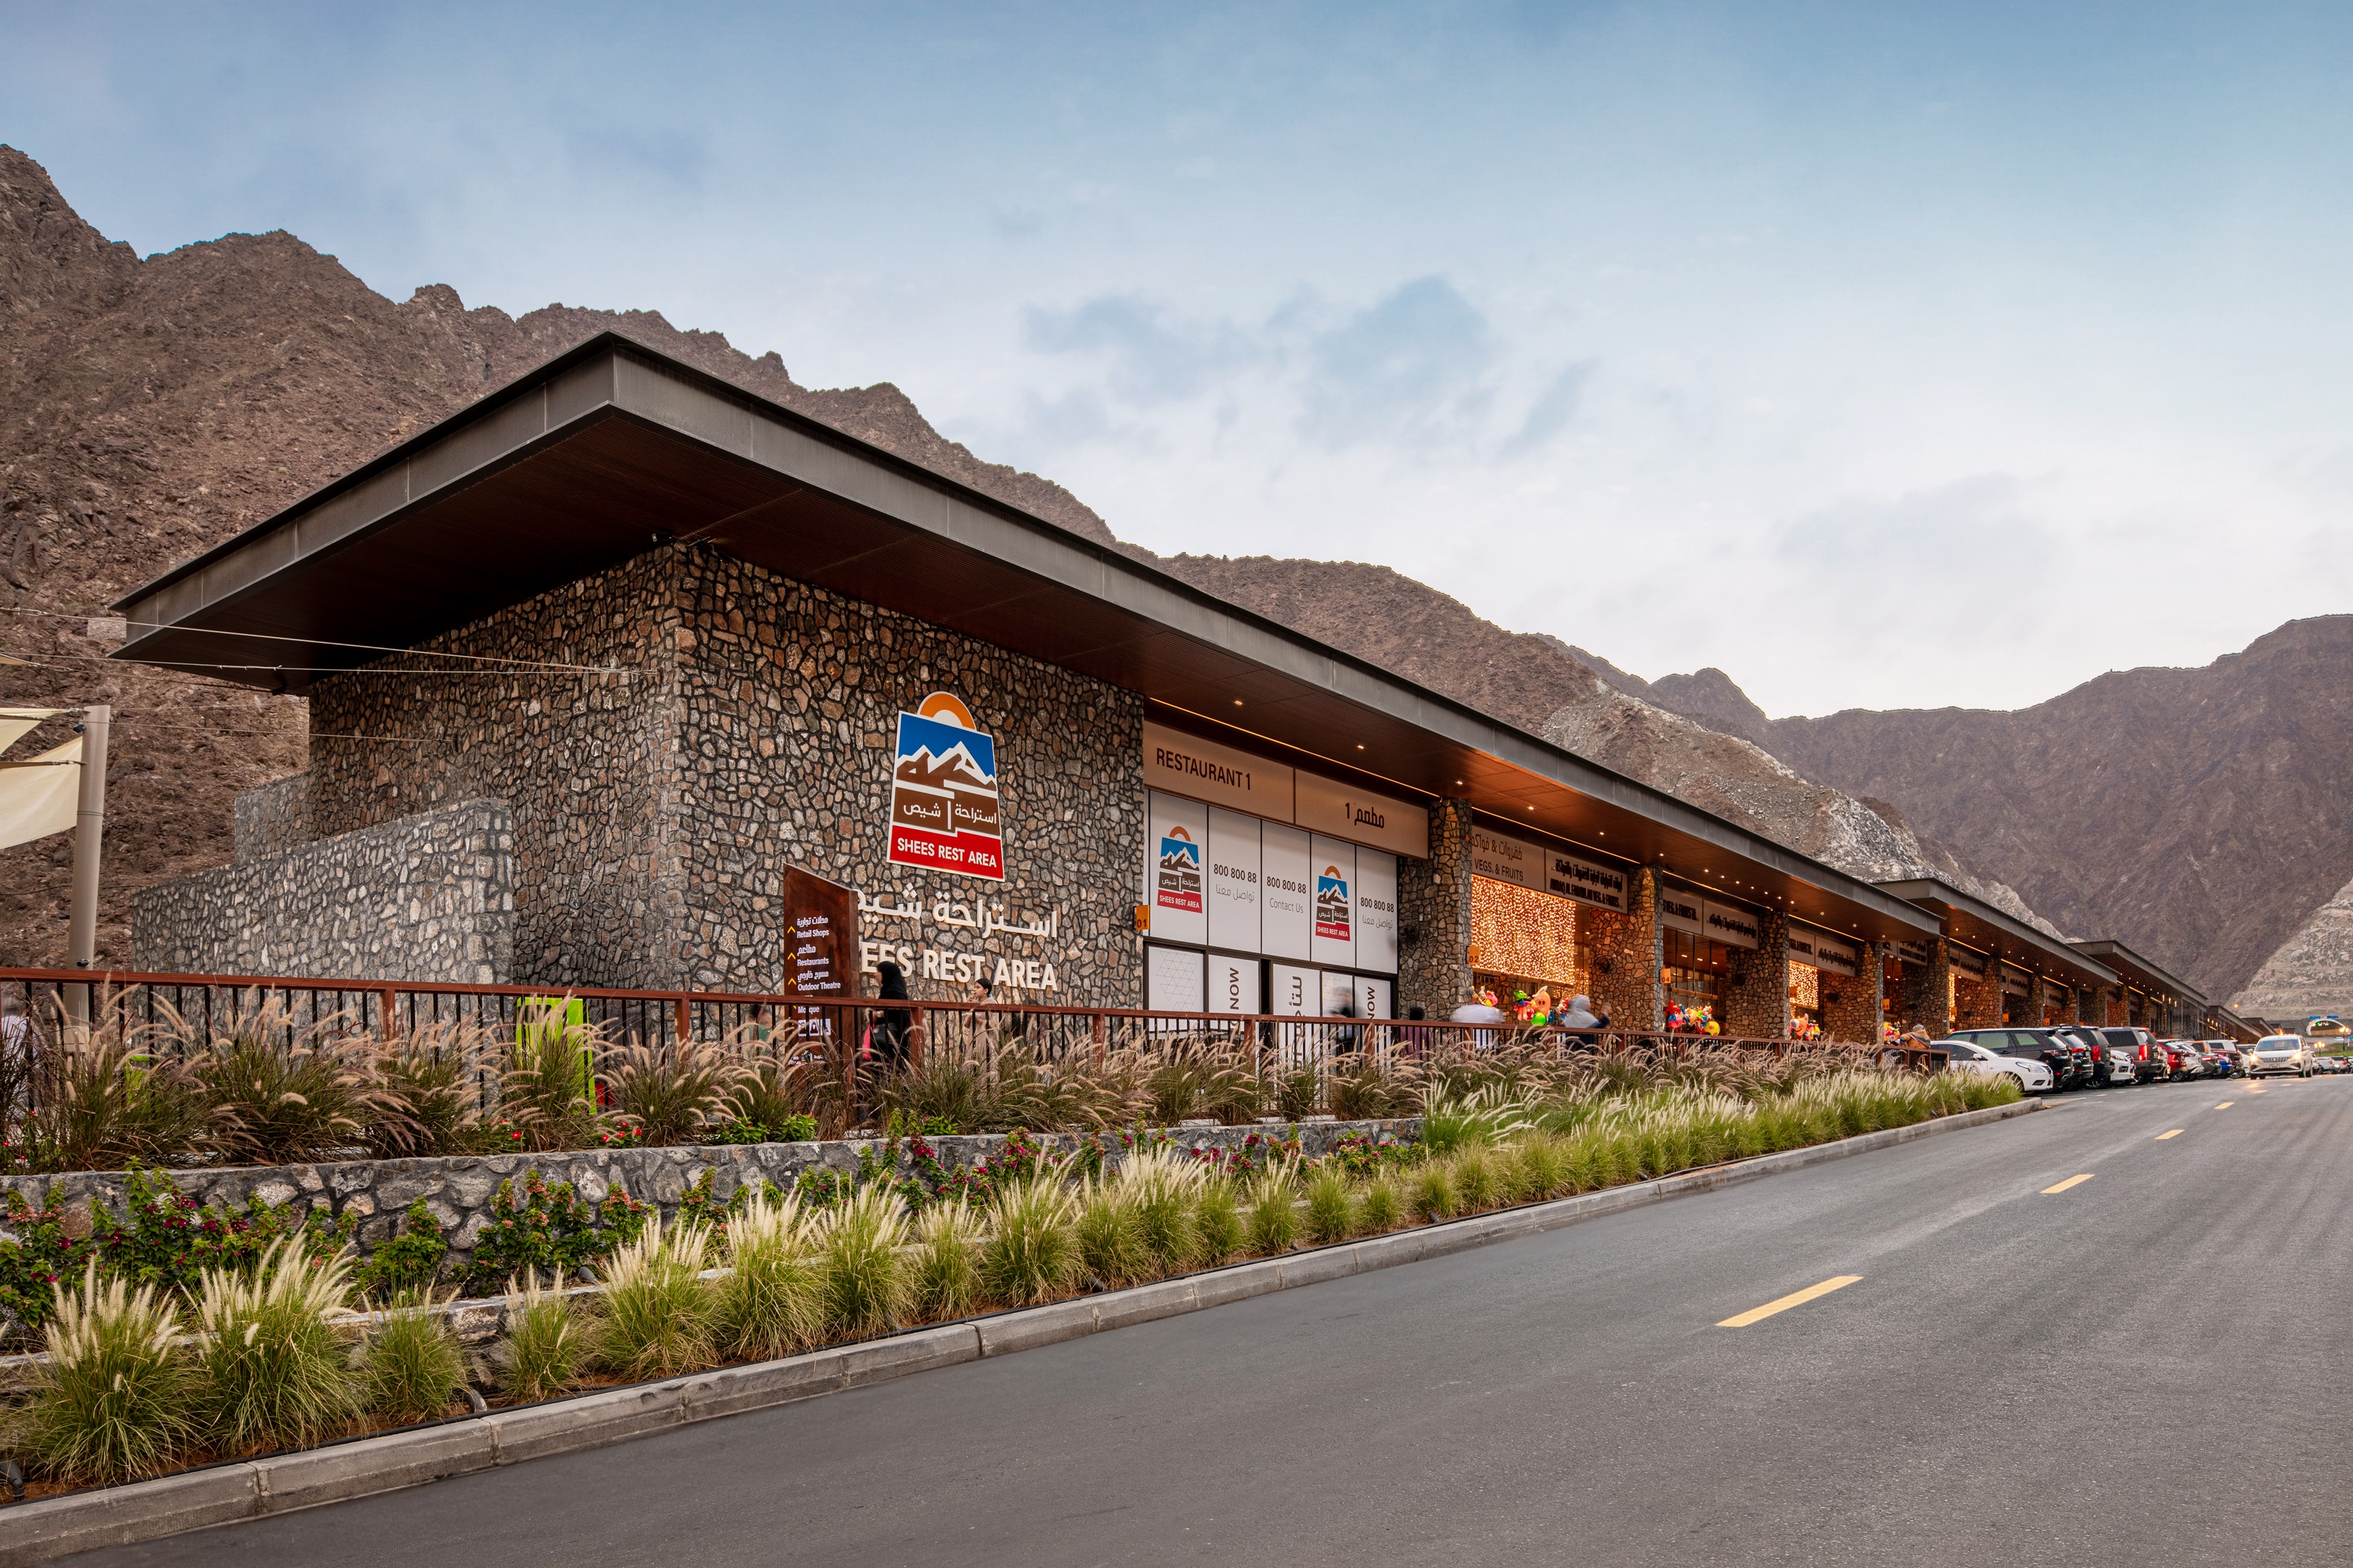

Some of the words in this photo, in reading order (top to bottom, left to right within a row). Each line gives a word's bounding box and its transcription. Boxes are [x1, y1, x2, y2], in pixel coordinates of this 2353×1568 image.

[1156, 747, 1243, 788] RESTAURANT
[1245, 773, 1251, 790] 1
[903, 802, 941, 818] شيص
[954, 803, 997, 824] استراحة
[1345, 802, 1351, 819] 1
[1354, 807, 1386, 829] مطعم
[897, 837, 935, 857] SHEES
[938, 844, 965, 862] REST
[967, 850, 997, 868] AREA
[1491, 839, 1497, 853] &
[1499, 841, 1522, 861] خضروات
[1213, 864, 1229, 876] 800
[1230, 868, 1246, 880] 800
[1247, 872, 1257, 883] 88
[1474, 858, 1494, 874] VEGS.
[1494, 864, 1500, 875] &
[1501, 865, 1523, 882] FRUITS
[1267, 876, 1281, 889] 800
[1282, 879, 1295, 892] 800
[1298, 883, 1306, 894] 88
[1159, 895, 1174, 904] SHEES
[1175, 897, 1187, 906] REST
[1187, 900, 1200, 909] AREA
[1233, 888, 1255, 903] تواصل
[1269, 897, 1294, 912] Contact
[1295, 903, 1304, 913] Us
[1360, 897, 1372, 908] 800
[1374, 899, 1386, 911] 800
[1387, 903, 1394, 913] 88
[932, 890, 1058, 939] استراحة
[1137, 919, 1147, 928] 01
[1317, 926, 1329, 934] SHEES
[1329, 928, 1338, 936] REST
[797, 930, 812, 938] Retail
[812, 929, 829, 938] Shops
[797, 957, 829, 966] Restaurants
[861, 942, 913, 978] EES
[923, 949, 986, 983] REST
[993, 958, 1058, 991] AREA
[797, 983, 819, 991] Outdoor
[1230, 967, 1239, 1010] NOW
[797, 1006, 820, 1014] Moque
